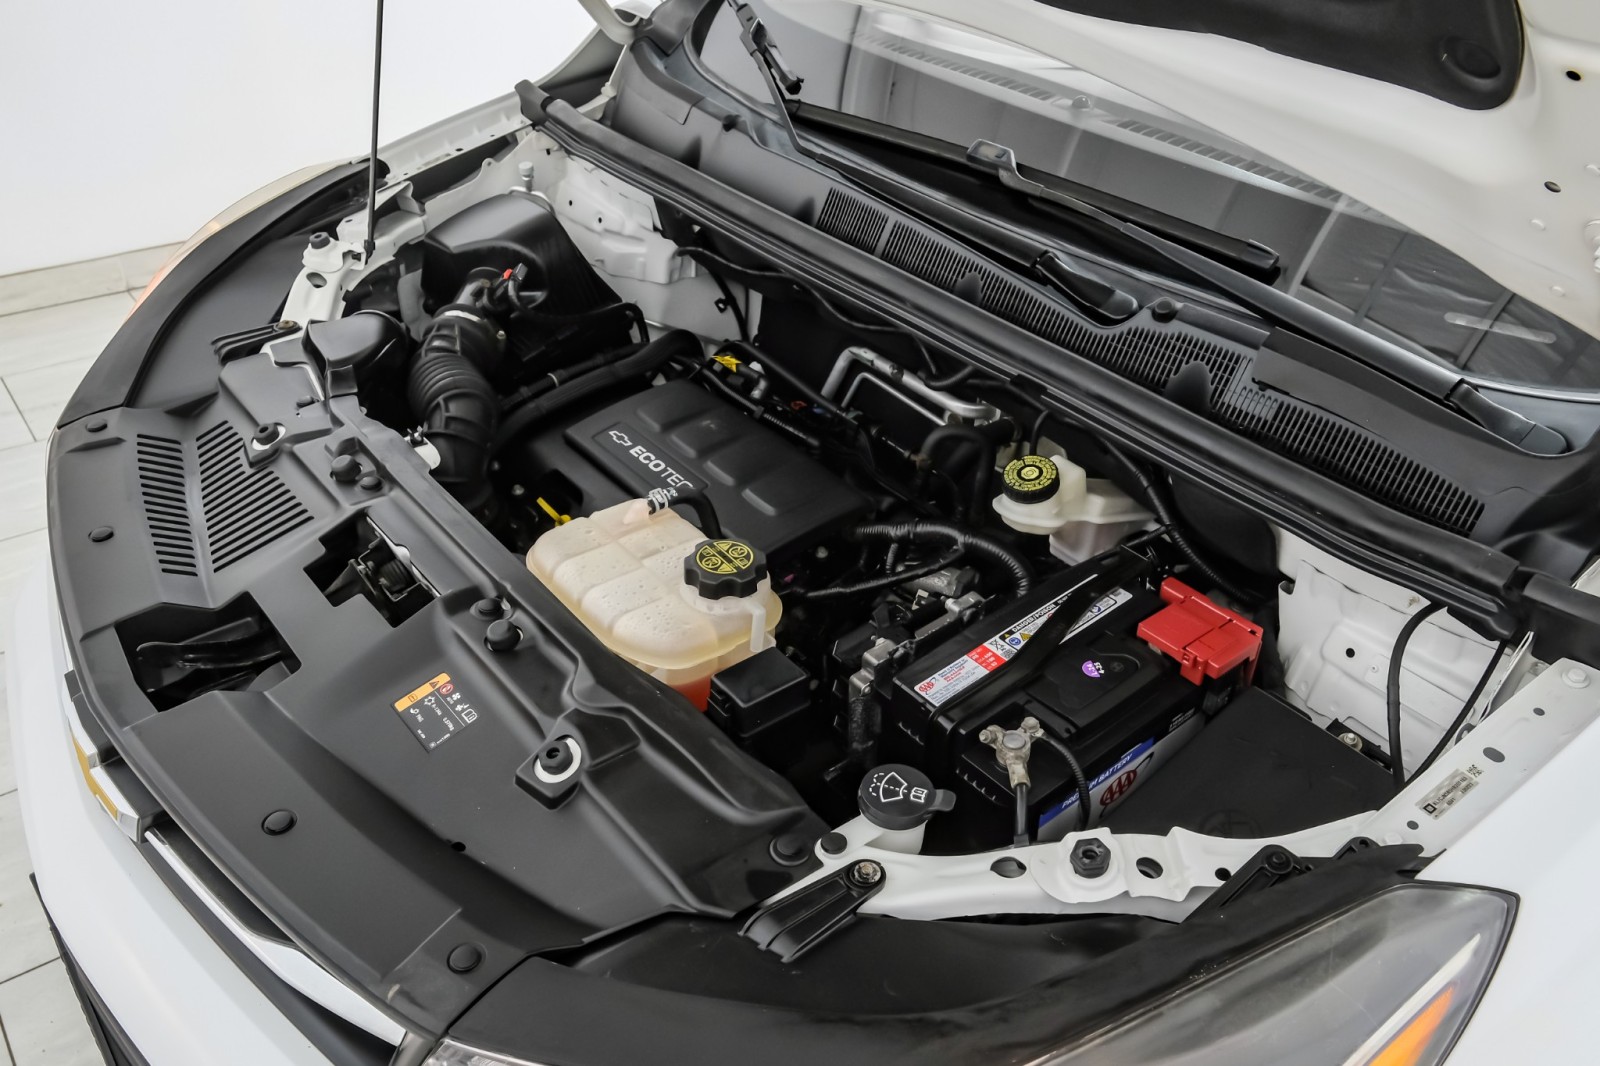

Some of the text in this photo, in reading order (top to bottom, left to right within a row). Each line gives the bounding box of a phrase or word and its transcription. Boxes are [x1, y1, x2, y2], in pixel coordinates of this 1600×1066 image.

[1011, 603, 1056, 632] DANGER/POISON
[1098, 753, 1133, 782] BATTERY
[1101, 770, 1137, 805] AAA
